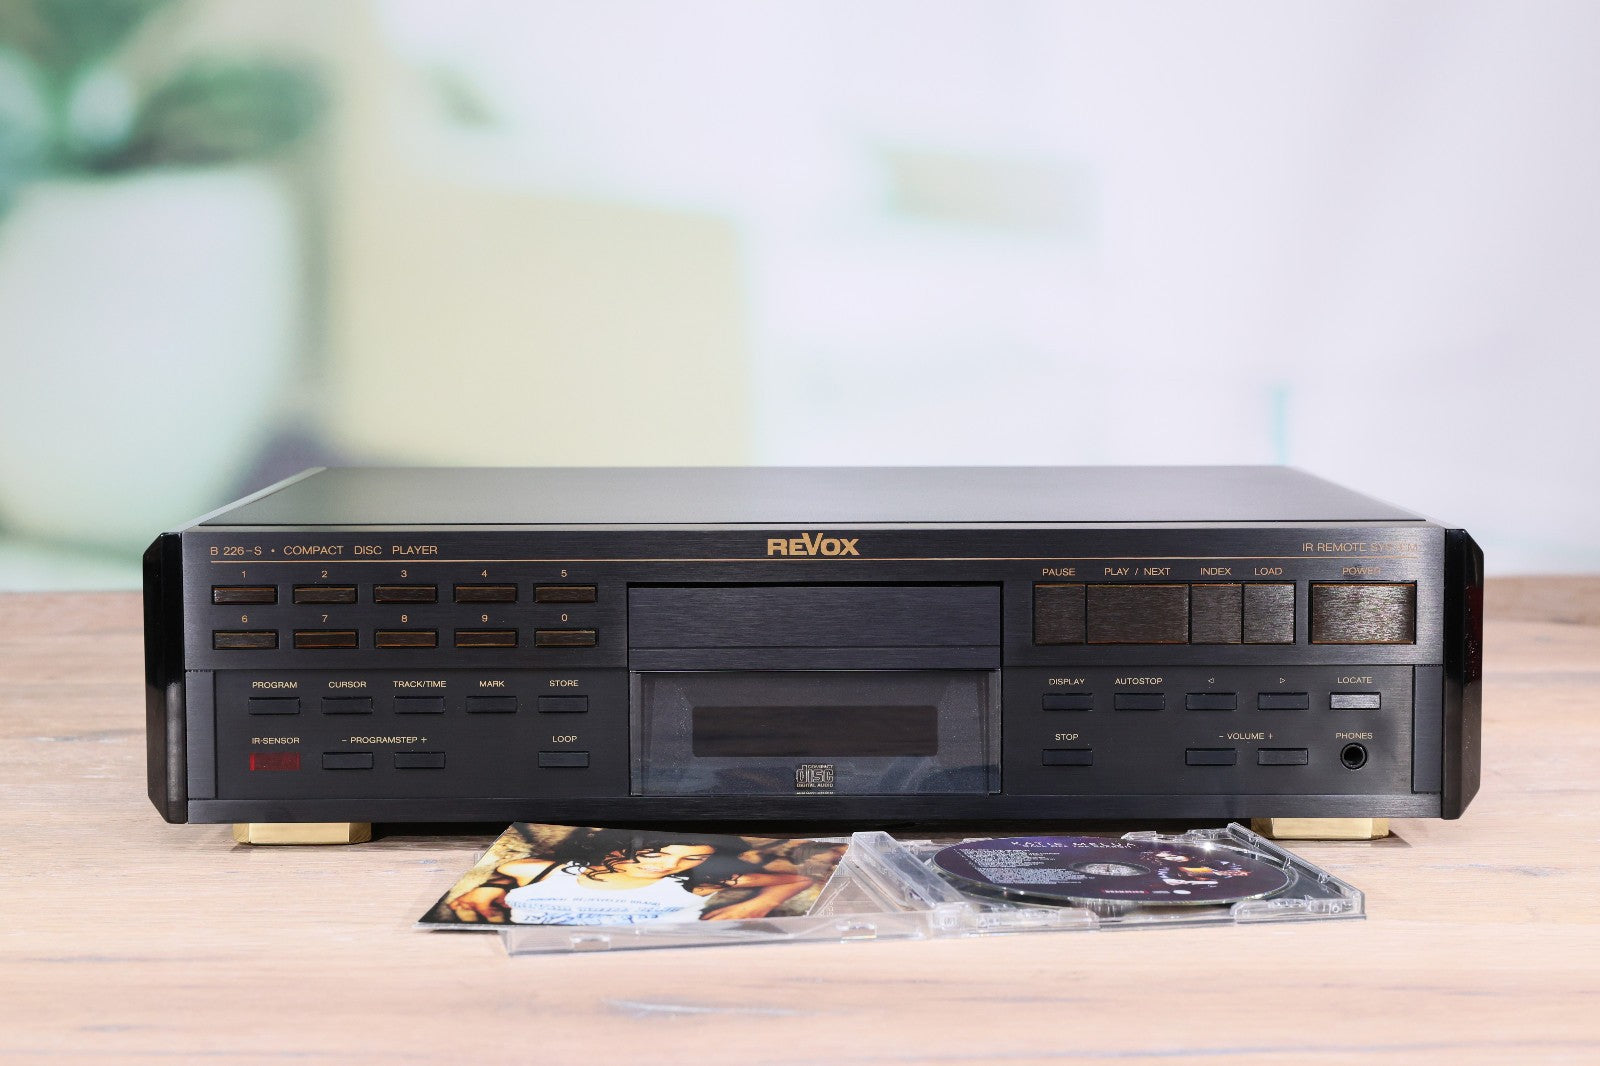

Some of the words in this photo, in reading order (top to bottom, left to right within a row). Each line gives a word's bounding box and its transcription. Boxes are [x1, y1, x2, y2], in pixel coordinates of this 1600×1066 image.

[210, 546, 219, 556] B
[223, 546, 262, 556] 226-S
[283, 545, 344, 555] COMPACT
[354, 545, 382, 555] DISC
[392, 545, 438, 555] PLAYER
[1302, 542, 1314, 552] IR
[1317, 542, 1367, 552] REMOTE
[241, 570, 247, 578] 1
[321, 570, 328, 578] 2
[400, 570, 407, 578] 3
[481, 569, 488, 578] 4
[560, 569, 567, 578] 5
[1042, 567, 1076, 577] PAUSE
[1104, 567, 1130, 576] PLAY
[1144, 567, 1171, 576] NEXT
[1200, 567, 1232, 576] INDEX
[1254, 567, 1283, 576] LOAD
[1342, 567, 1381, 575] POWER
[241, 615, 248, 623] 6
[321, 614, 328, 623] 7
[401, 614, 408, 623] 8
[481, 614, 488, 623] 9
[561, 613, 568, 622] 0
[252, 681, 298, 689] PROGRAM
[328, 681, 367, 689] CURSOR
[393, 680, 447, 688] TRACK/TIME
[479, 680, 505, 688] MARK
[549, 679, 579, 688] STORE
[1048, 677, 1086, 686] DISPLAY
[1114, 677, 1163, 686] AUTOSTOP
[1337, 676, 1373, 685] LOCATE
[350, 736, 418, 745] PROGRAMSTEP
[552, 735, 578, 743] LOOP
[1054, 733, 1079, 741] STOP
[1227, 732, 1265, 740] VOLUME
[1335, 732, 1374, 741] PHONES
[251, 737, 300, 745] IR-SENSOR
